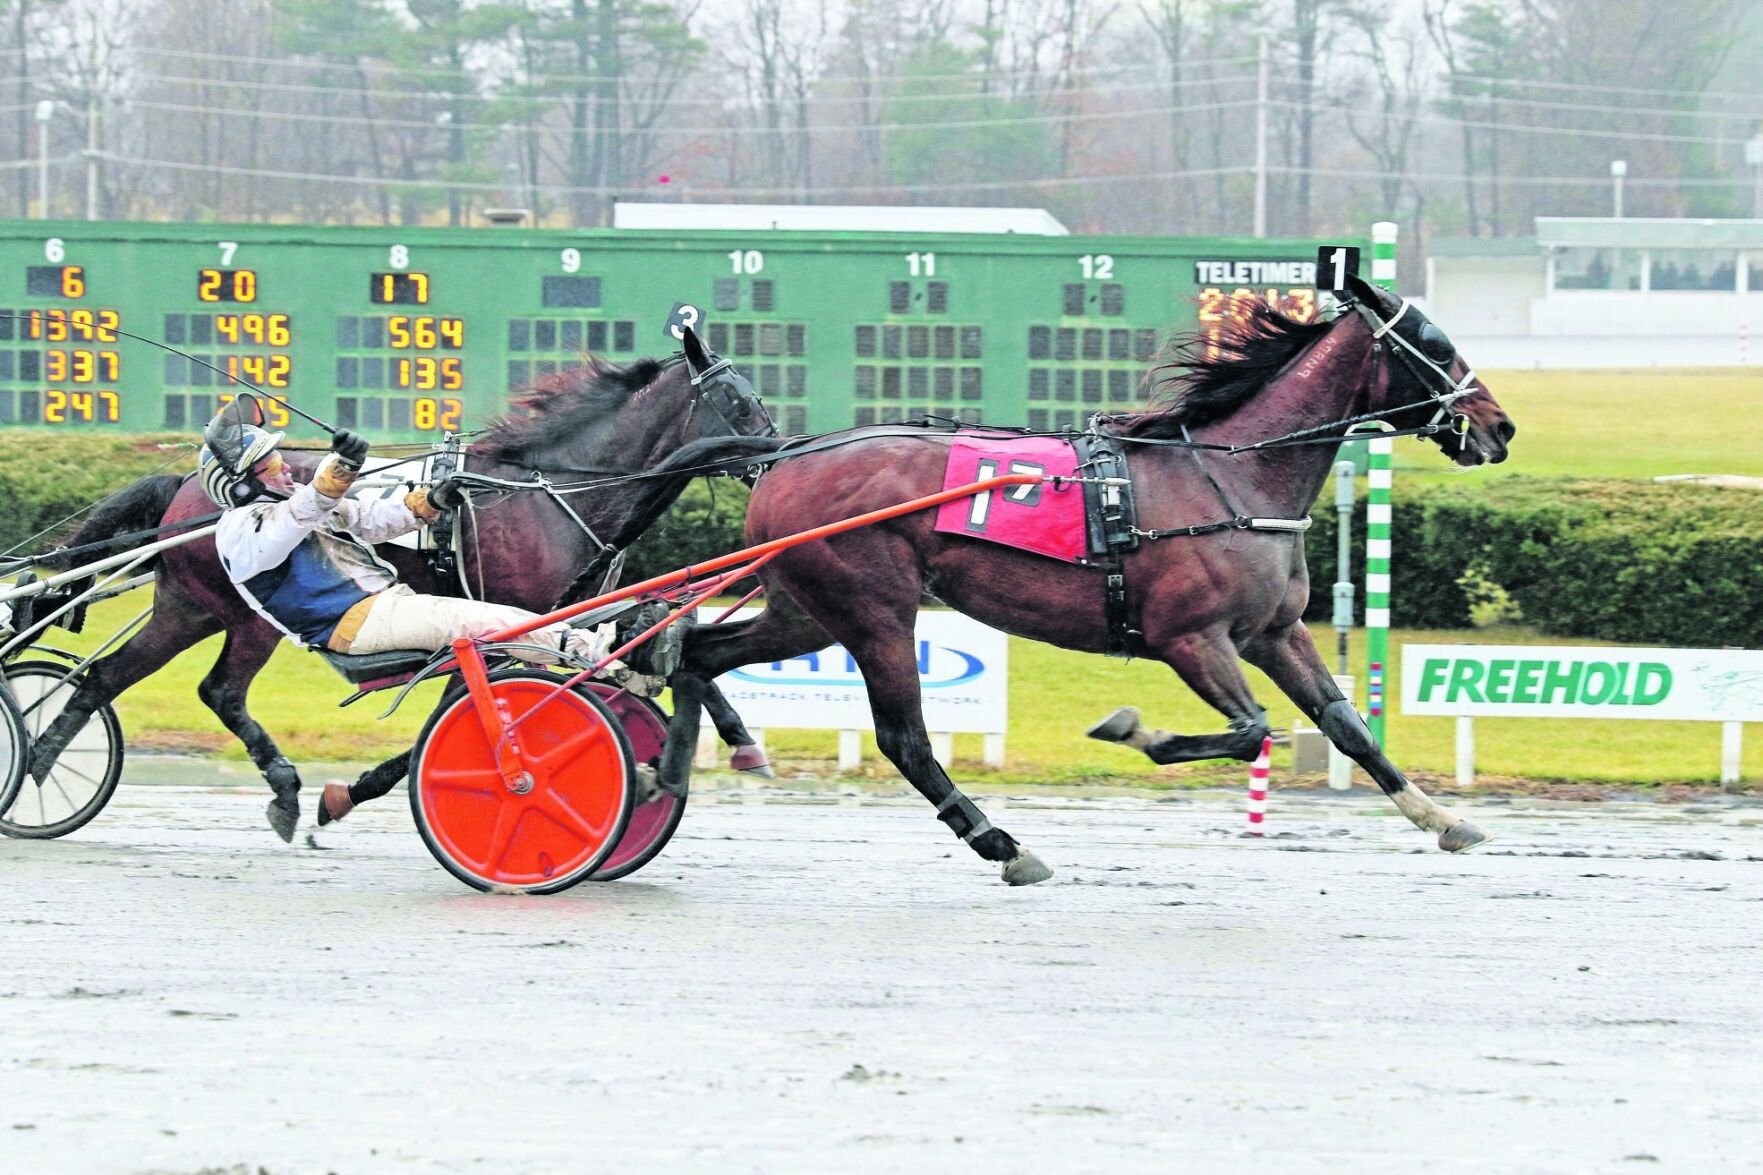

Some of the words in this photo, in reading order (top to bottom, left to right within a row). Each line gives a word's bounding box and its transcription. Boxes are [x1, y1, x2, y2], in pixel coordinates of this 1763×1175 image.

[45, 238, 65, 263] 6
[218, 241, 239, 266] 7
[389, 244, 409, 269] 8
[561, 248, 581, 273] 9
[728, 250, 764, 274] 10
[905, 252, 935, 276] 11
[1078, 254, 1114, 279] 12
[62, 266, 85, 298] 6
[1195, 261, 1316, 284] TELETIMER
[1330, 248, 1347, 290] 1
[200, 270, 256, 302] 20
[383, 273, 429, 303] 17
[30, 310, 119, 342] 1392
[216, 314, 291, 346] 496
[388, 316, 464, 349] 564
[670, 305, 699, 340] 3
[47, 350, 119, 382] 337
[228, 355, 291, 387] 142
[400, 358, 464, 390] 135
[44, 390, 119, 422] 247
[415, 398, 463, 430] 82
[1417, 658, 1673, 706] FREEHOLD
